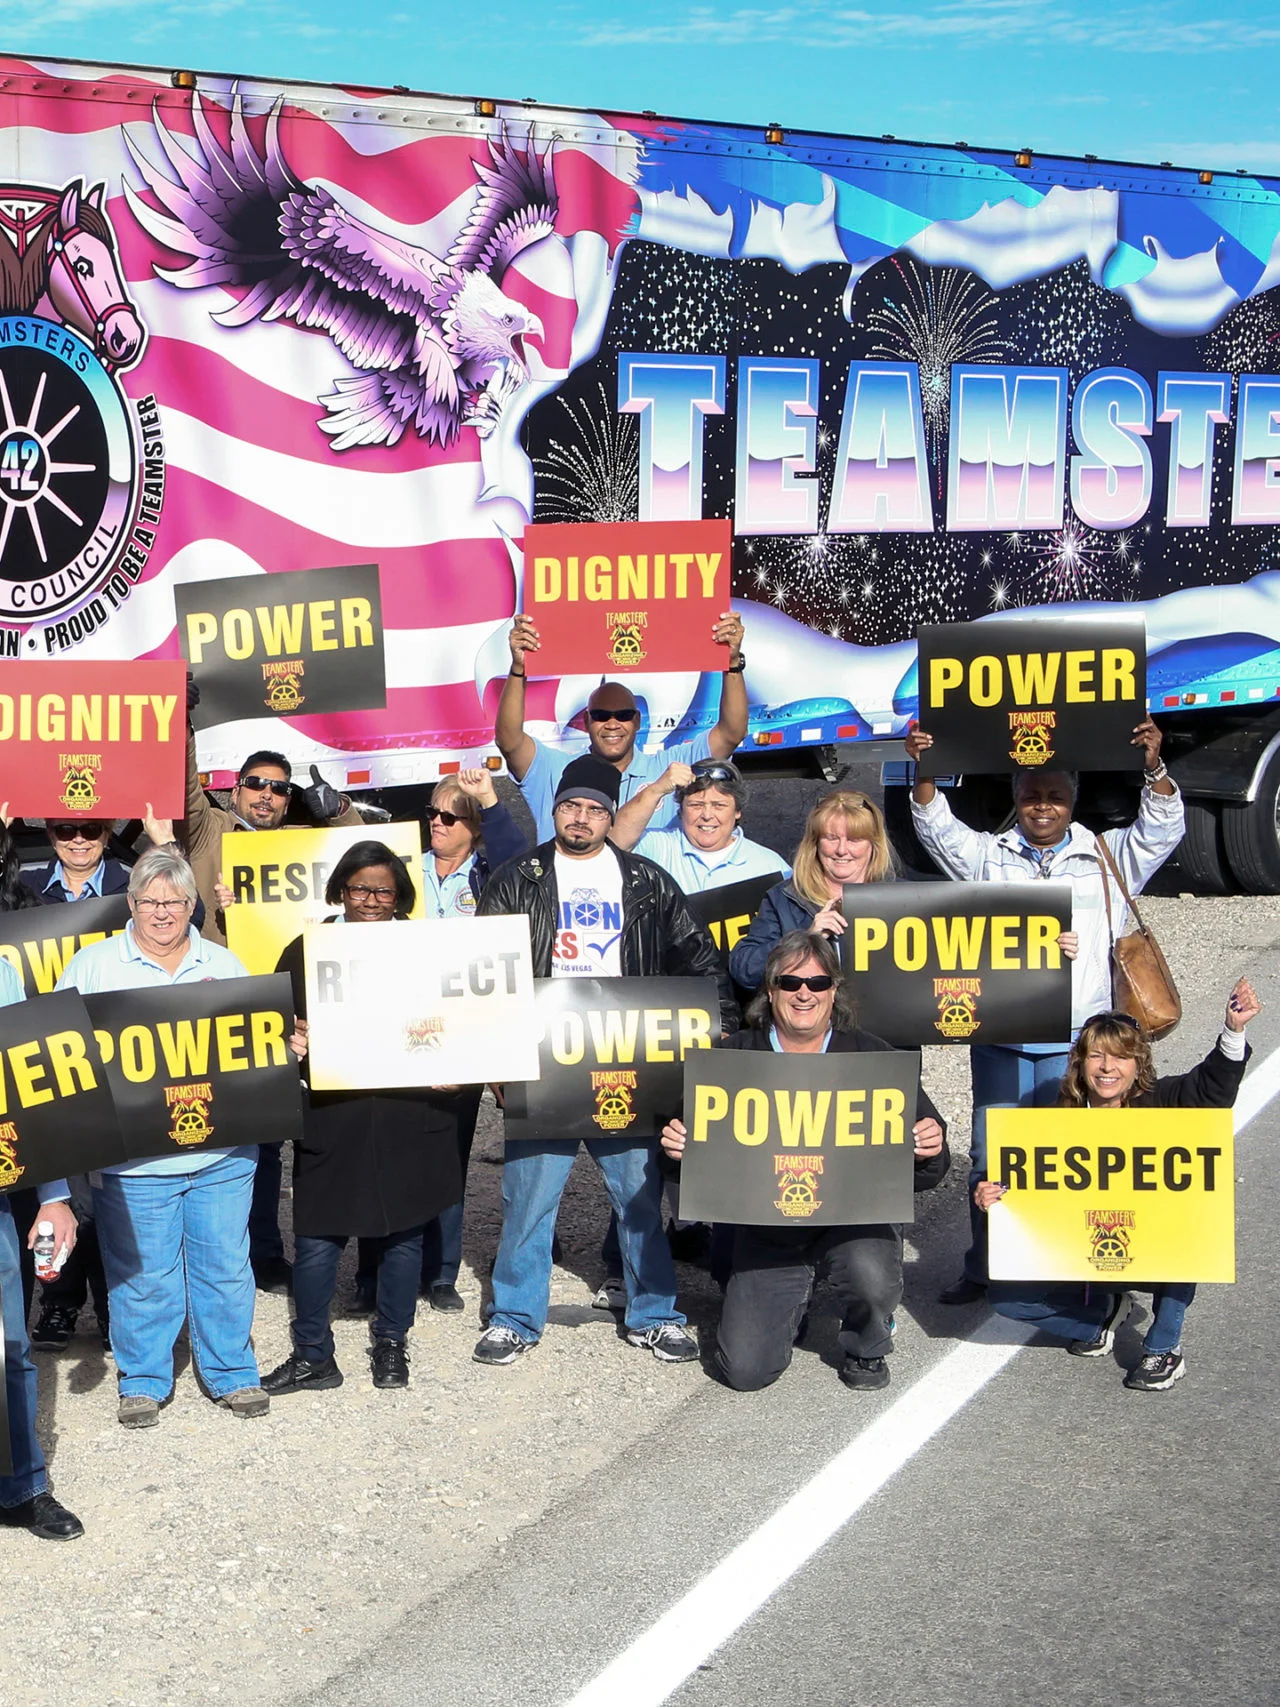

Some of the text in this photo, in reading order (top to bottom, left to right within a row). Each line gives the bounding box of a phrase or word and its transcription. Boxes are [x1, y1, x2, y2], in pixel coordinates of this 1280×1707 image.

[2, 440, 40, 490] 42
[136, 393, 164, 524] TEAMSTER
[617, 351, 1280, 536] TEAMSTE
[134, 528, 156, 547] A
[11, 524, 118, 607] COUNCIL
[120, 545, 147, 579] BE
[534, 553, 722, 602] DIGNITY
[102, 573, 129, 608] TO
[44, 602, 108, 653] PROUD
[186, 597, 374, 664] POWER
[606, 611, 648, 629] TEAMSTERS
[261, 660, 305, 680] TEAMSTERS
[930, 648, 1136, 708] POWER
[1008, 711, 1056, 729] TEAMSTERS
[58, 753, 102, 771] TEAMSTERS
[854, 915, 1061, 972] POWER
[316, 952, 520, 1002] RECT
[932, 978, 981, 997] TEAMSTERS
[539, 1008, 711, 1065] OWER
[164, 1082, 213, 1107] TEAMSTERS
[590, 1071, 637, 1090] TEAMSTERS
[692, 1084, 905, 1147] POWER
[774, 1155, 824, 1174] TEAMSTERS
[1000, 1146, 1222, 1191] RESPECT
[1084, 1209, 1136, 1230] TEAMSTERS
